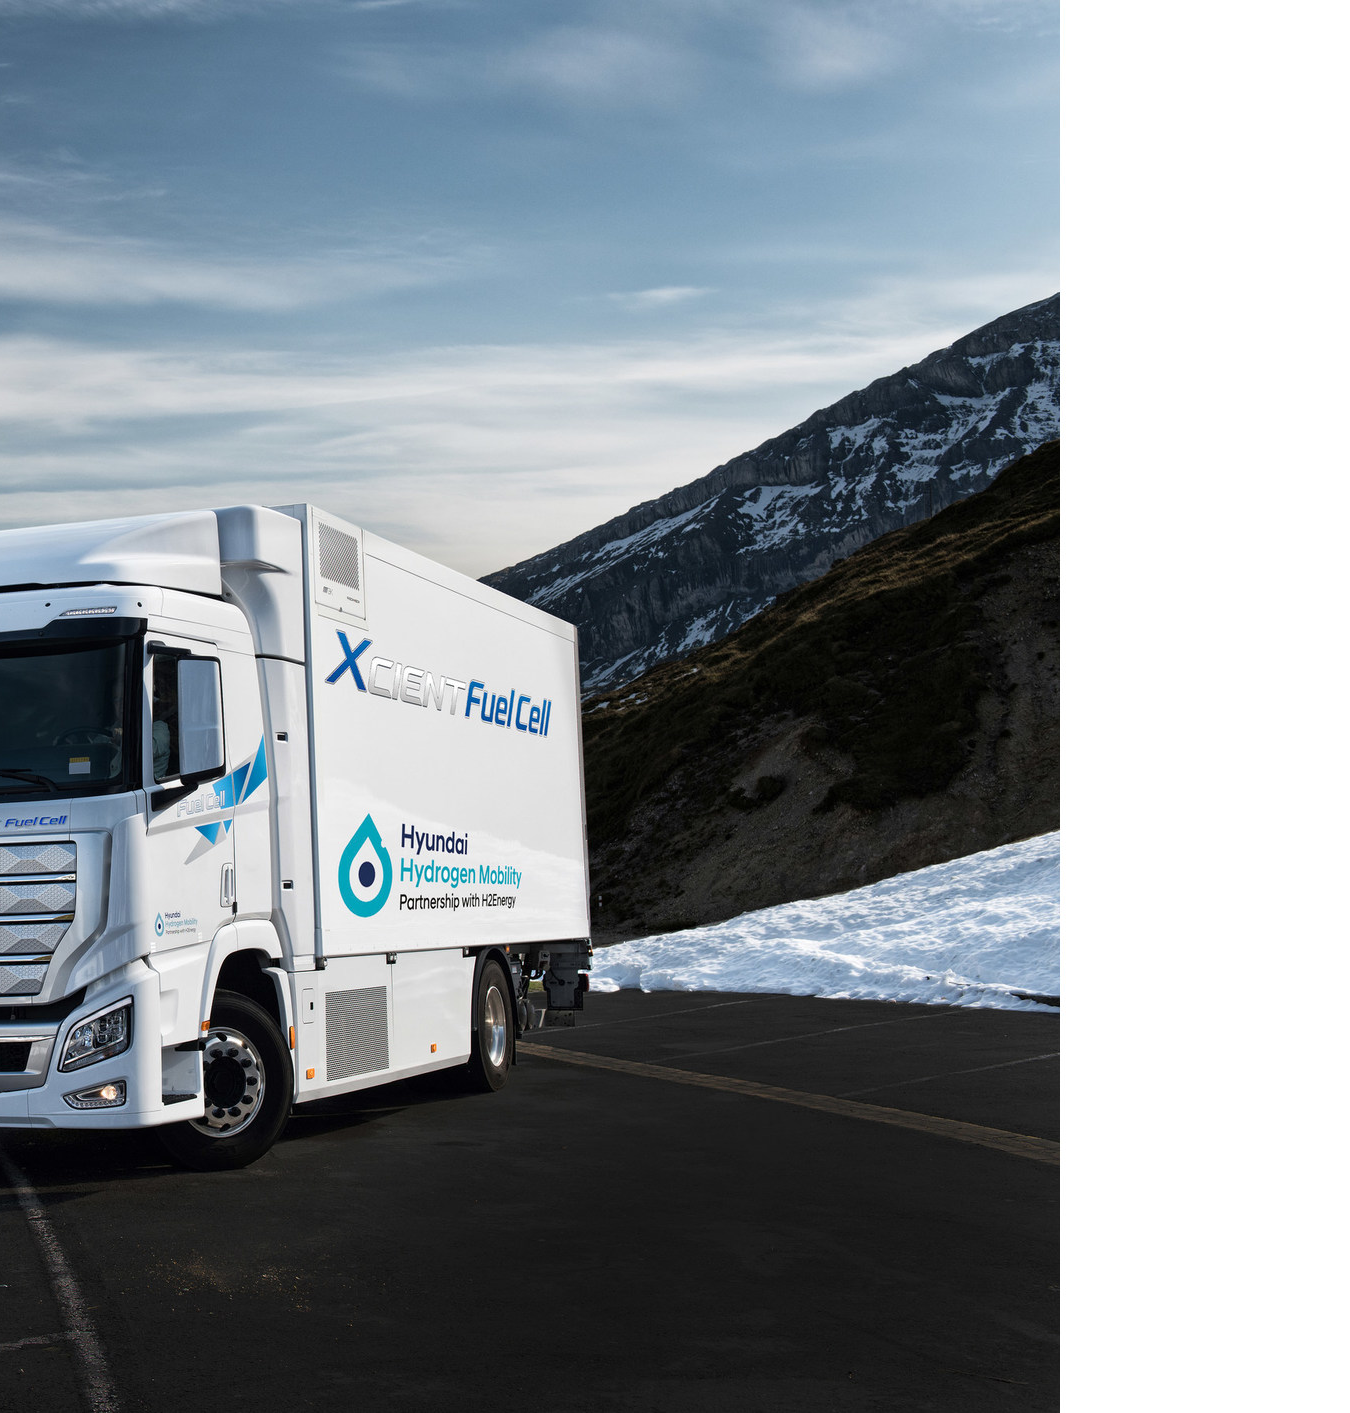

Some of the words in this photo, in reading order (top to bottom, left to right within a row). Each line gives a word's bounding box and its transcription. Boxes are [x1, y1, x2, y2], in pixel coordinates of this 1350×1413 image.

[325, 629, 466, 715] XCIENT
[465, 679, 515, 729] Fuel
[515, 694, 552, 738] Cell
[177, 794, 204, 817] Fuel
[205, 790, 225, 810] Cell
[5, 816, 38, 828] Fuel
[39, 815, 68, 826] Cell
[401, 823, 468, 855] Hyundai
[400, 857, 476, 888] Hydrogen
[479, 864, 522, 889] Mobility
[399, 893, 460, 911] Partnership
[462, 893, 480, 908] with
[481, 893, 516, 909] H2Energy
